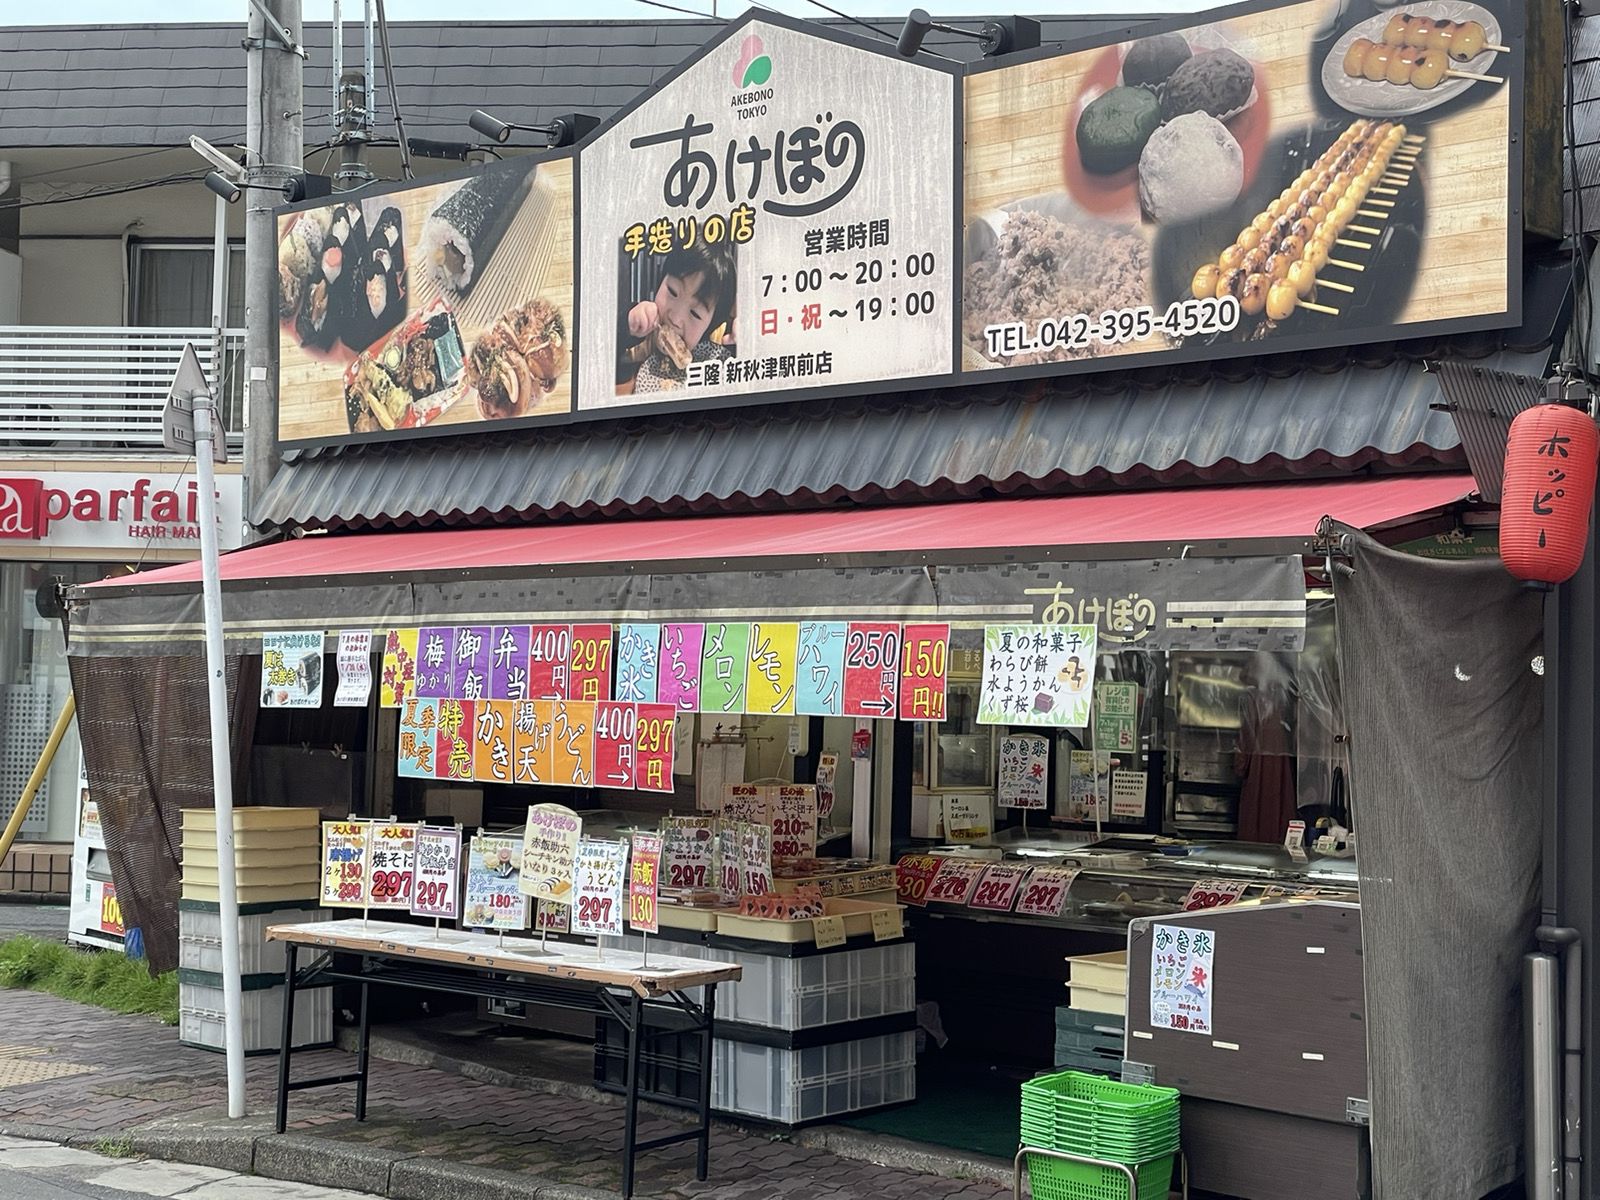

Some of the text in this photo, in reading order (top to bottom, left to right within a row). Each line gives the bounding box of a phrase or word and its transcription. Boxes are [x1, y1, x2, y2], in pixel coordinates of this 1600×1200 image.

[730, 88, 774, 108] AKEBONO
[736, 104, 768, 121] TOKYO
[630, 114, 866, 217] あけぼの
[624, 204, 756, 259] 手造りの店
[804, 219, 890, 257] 営業時間
[987, 300, 1237, 353] TEL.042-395-4520
[688, 351, 833, 388] 三隆 新秋津駅前店
[1533, 428, 1571, 548] ホッピー
[129, 525, 166, 538] HAIR
[1024, 581, 1157, 643] あけぼの
[424, 634, 446, 668] 梅
[998, 632, 1082, 653] 夏の和菓子
[455, 628, 484, 700] 御飯
[494, 628, 527, 700] 弁当
[531, 630, 569, 688] 400 円
[572, 639, 611, 701] 297 円
[618, 626, 657, 702] かき氷
[664, 625, 698, 710] いちご
[704, 624, 743, 711] メロン
[751, 624, 794, 713] レモン
[847, 632, 898, 694] 250 円
[902, 640, 946, 678] 150
[990, 654, 1048, 673] わらび餅
[416, 672, 450, 691] ゆかり
[987, 674, 1061, 693] 水ようかん
[987, 695, 1029, 713] くず桜
[438, 699, 473, 779] 特売
[477, 701, 510, 780] かき
[555, 702, 591, 785] うどん
[596, 707, 635, 769] 400 円
[1002, 739, 1047, 758] かき氷
[637, 718, 674, 789] 297 円
[773, 818, 802, 836] 210
[531, 837, 571, 855] 赤飯助六
[523, 859, 549, 875] いなり
[587, 872, 617, 887] うどん
[632, 860, 655, 886] 赤飯
[671, 865, 706, 887] 297
[371, 871, 413, 898] 297
[416, 881, 449, 907] 297
[745, 871, 769, 896] 150
[977, 881, 1011, 903] 297
[1025, 885, 1060, 907] 297
[488, 894, 511, 909] 180
[578, 895, 613, 923] 297
[631, 894, 653, 924] 130
[1187, 891, 1236, 911] 297
[1155, 928, 1212, 957] かき氷
